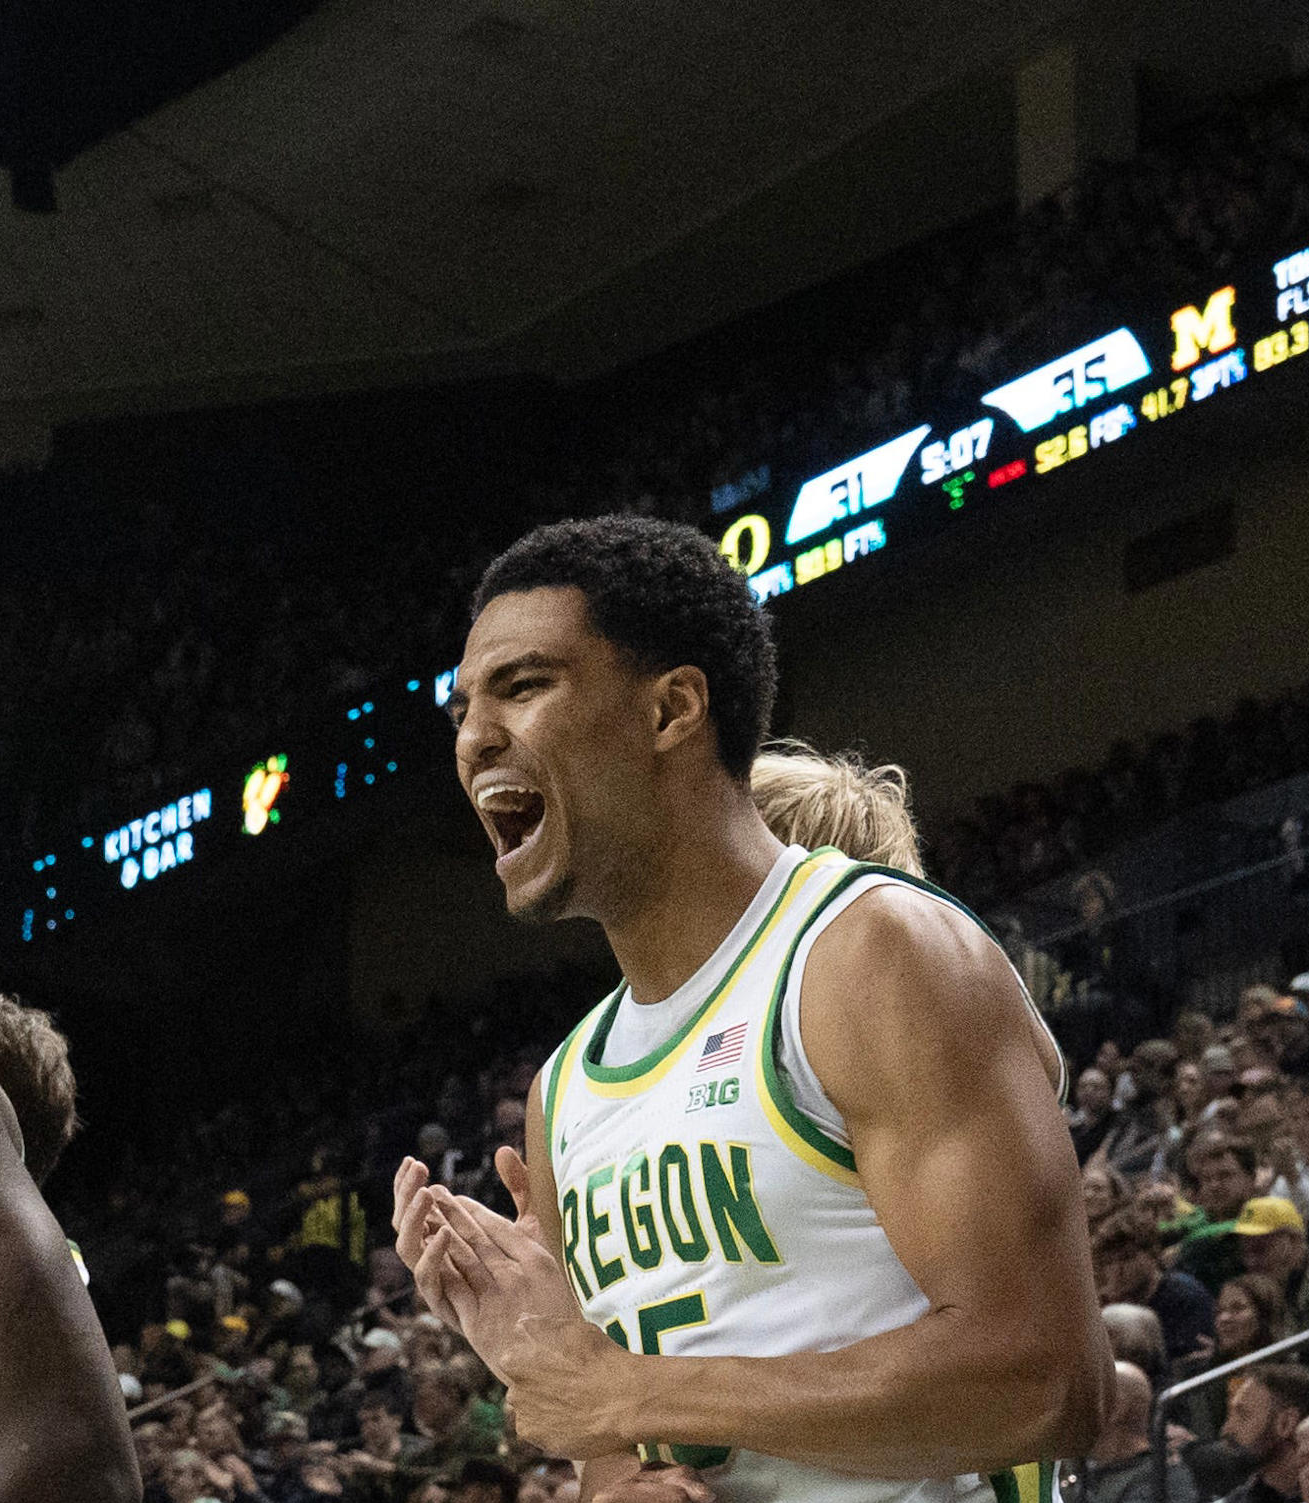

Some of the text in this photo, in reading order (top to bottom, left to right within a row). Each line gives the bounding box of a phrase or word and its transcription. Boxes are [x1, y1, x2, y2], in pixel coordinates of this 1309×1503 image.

[1170, 284, 1237, 373] M
[103, 786, 213, 865] KITCHEN
[142, 829, 195, 882] BAR
[559, 1140, 786, 1304] REGON
